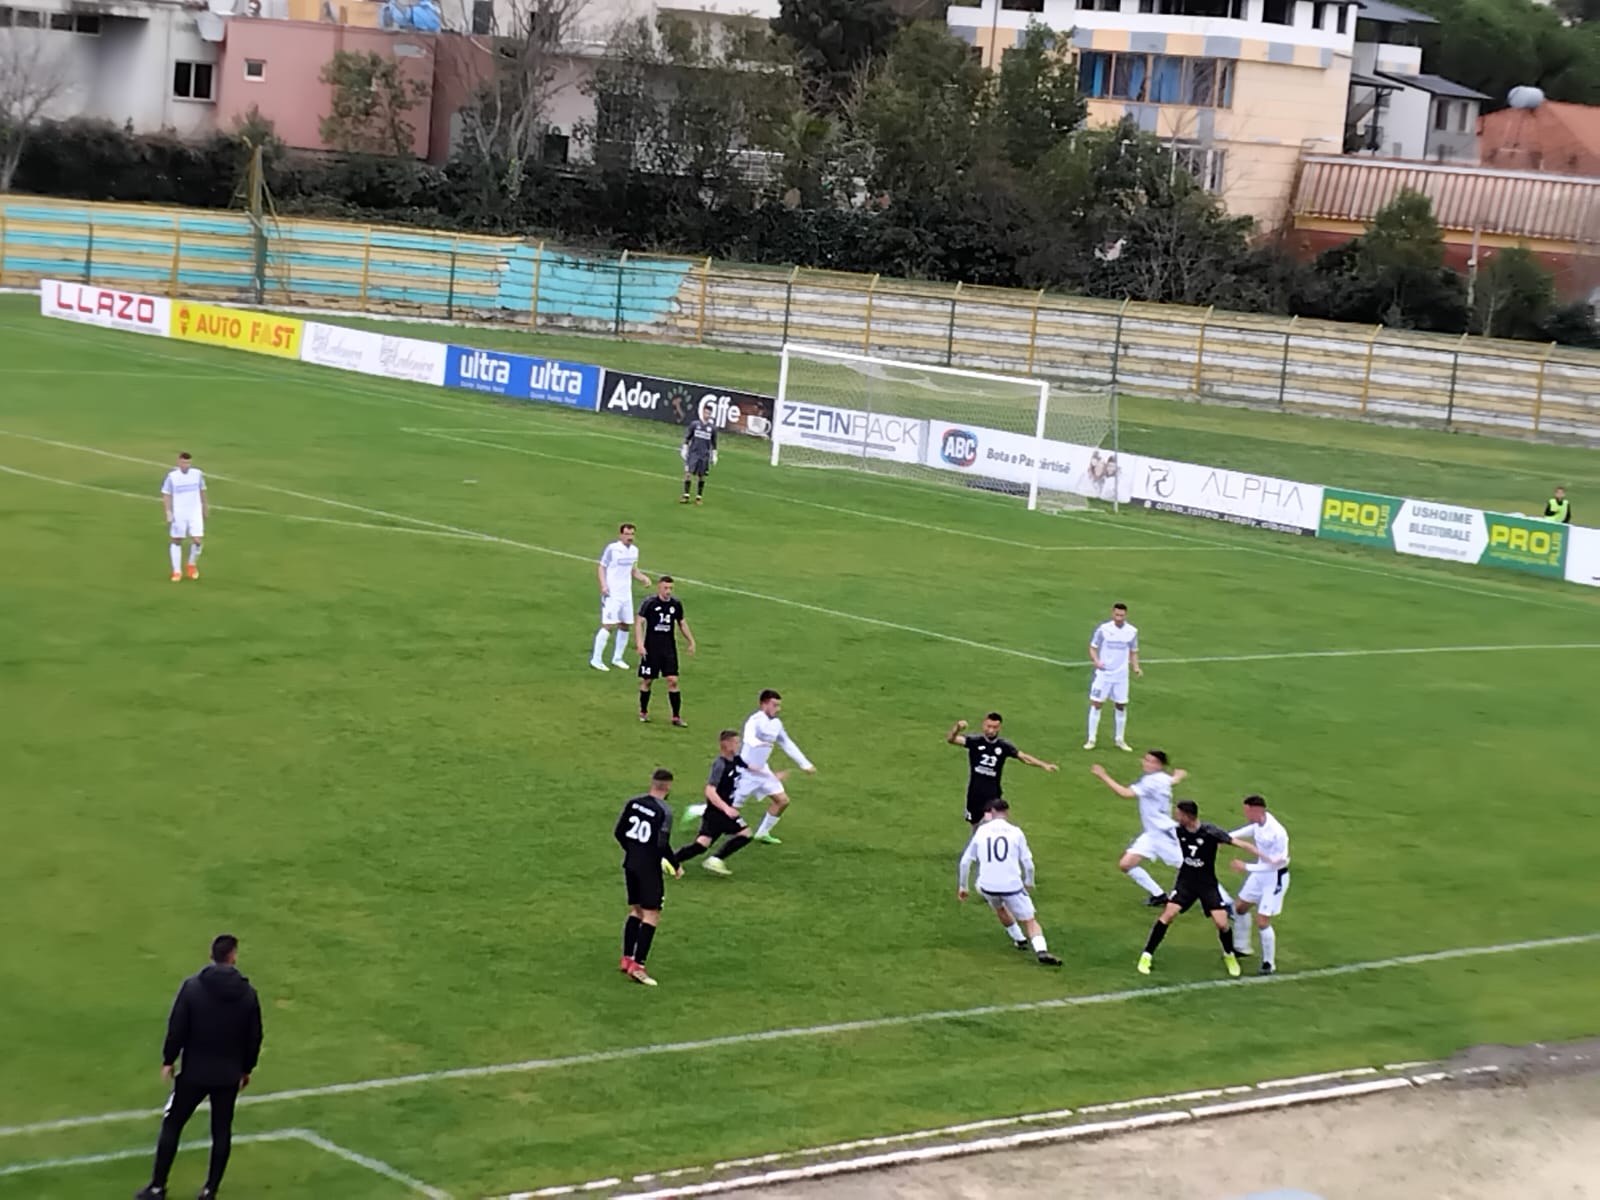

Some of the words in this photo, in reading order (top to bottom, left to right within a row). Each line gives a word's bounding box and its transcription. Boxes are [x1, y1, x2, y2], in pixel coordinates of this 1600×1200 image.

[56, 284, 155, 323] LLAZO
[196, 313, 242, 338] AUTO
[250, 321, 295, 349] FAST
[460, 351, 511, 384] ultra
[530, 361, 583, 395] ultra
[608, 379, 661, 411] Ador
[944, 436, 976, 460] ABC
[986, 448, 1010, 462] Bota
[1011, 454, 1017, 465] e
[1201, 471, 1304, 511] ALPHA
[1323, 498, 1380, 527] PRO
[1411, 505, 1473, 525] USHQIME
[1490, 525, 1550, 555] PRO
[659, 612, 671, 624] 14
[641, 666, 651, 676] 14
[979, 753, 998, 767] 23
[625, 815, 652, 843] 20
[986, 836, 1009, 863] 10
[1187, 844, 1199, 857] 7
